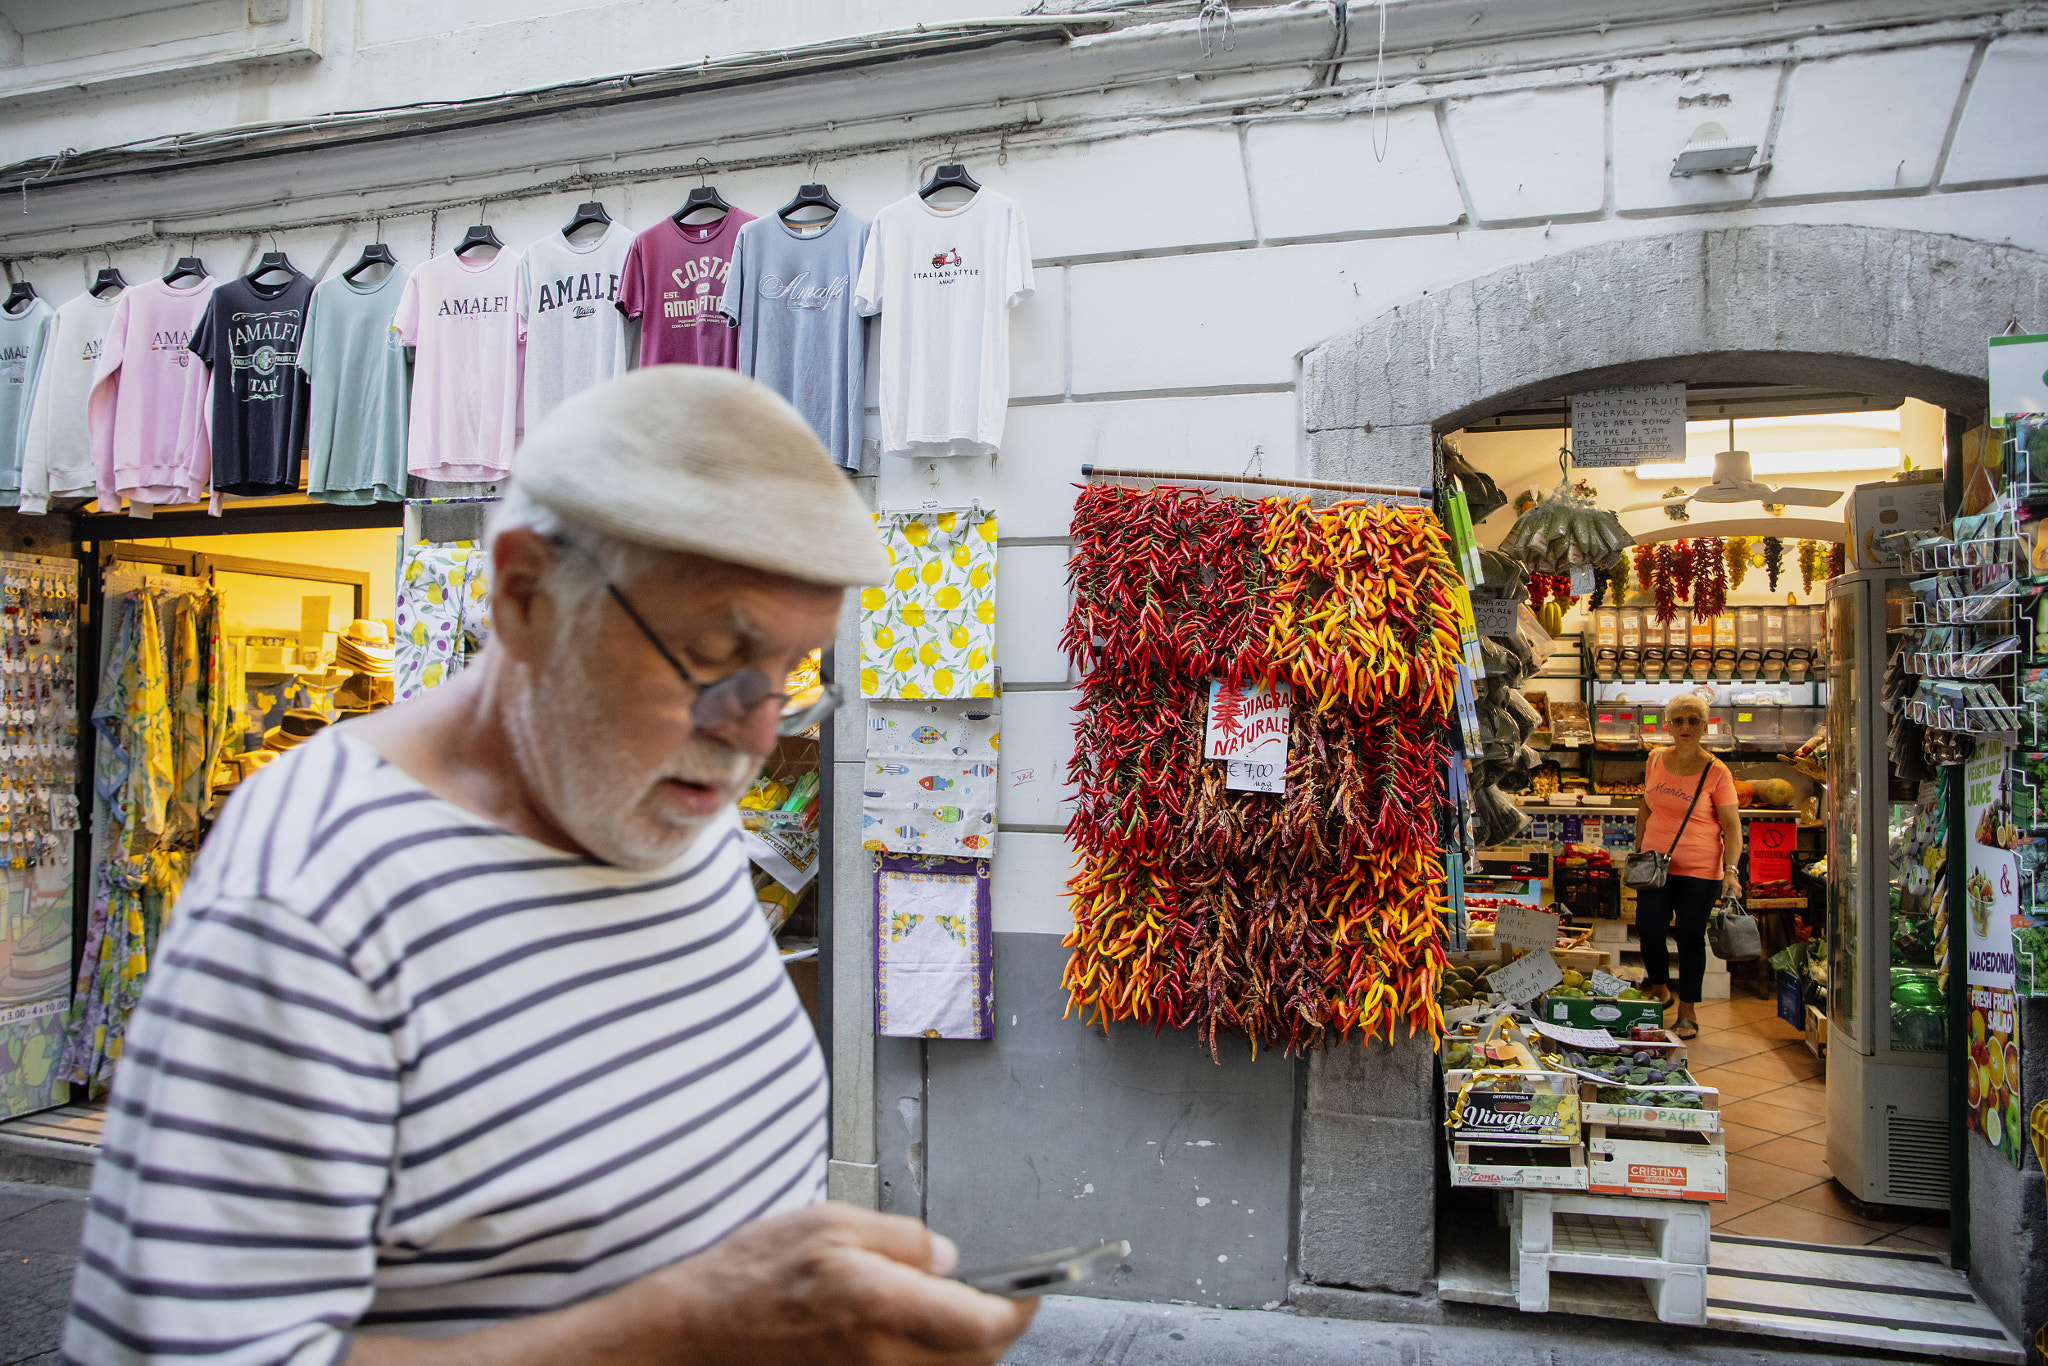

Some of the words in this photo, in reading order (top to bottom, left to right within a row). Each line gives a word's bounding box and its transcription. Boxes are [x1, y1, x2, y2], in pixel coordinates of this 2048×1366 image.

[672, 256, 731, 289] COSTA
[664, 292, 680, 300] EST.
[759, 271, 848, 311] Amalfi
[438, 296, 508, 316] AMALFI
[573, 306, 596, 316] Italia
[235, 322, 299, 346] AMALFI
[1575, 400, 1610, 408] TOUCH
[1644, 397, 1680, 406] FRUIT
[1592, 408, 1648, 418] EVERYBODY
[1592, 421, 1608, 429] WE
[1604, 437, 1643, 445] FAVORE
[1243, 692, 1290, 720] VIAGRA
[1213, 716, 1289, 756] NATURALE
[1227, 762, 1240, 778] €
[1244, 763, 1274, 780] 7,00
[1968, 759, 2002, 782] VEGETABLE
[1646, 782, 1694, 802] Marina
[1968, 781, 1992, 807] JUICE
[758, 831, 789, 856] Sorrento
[2000, 864, 2012, 897] &
[1500, 904, 1528, 918] BITTE
[1498, 918, 1531, 930] NICHT
[1490, 968, 1512, 984] POR
[1516, 946, 1546, 968] FAVOR
[1969, 951, 2014, 975] MACEDONIA
[1496, 980, 1509, 990] NO
[7, 1009, 26, 1020] 3.00
[32, 1006, 38, 1014] 4
[46, 1000, 67, 1012] 10.00
[1972, 990, 1992, 1010] FRESH
[1993, 992, 2014, 1012] FRUIT
[1988, 1010, 2013, 1034] SALAD
[1463, 1106, 1561, 1131] Vingiani
[1606, 1106, 1642, 1118] AGRI
[1658, 1110, 1696, 1124] PACK
[1630, 1166, 1684, 1178] CRISTINA
